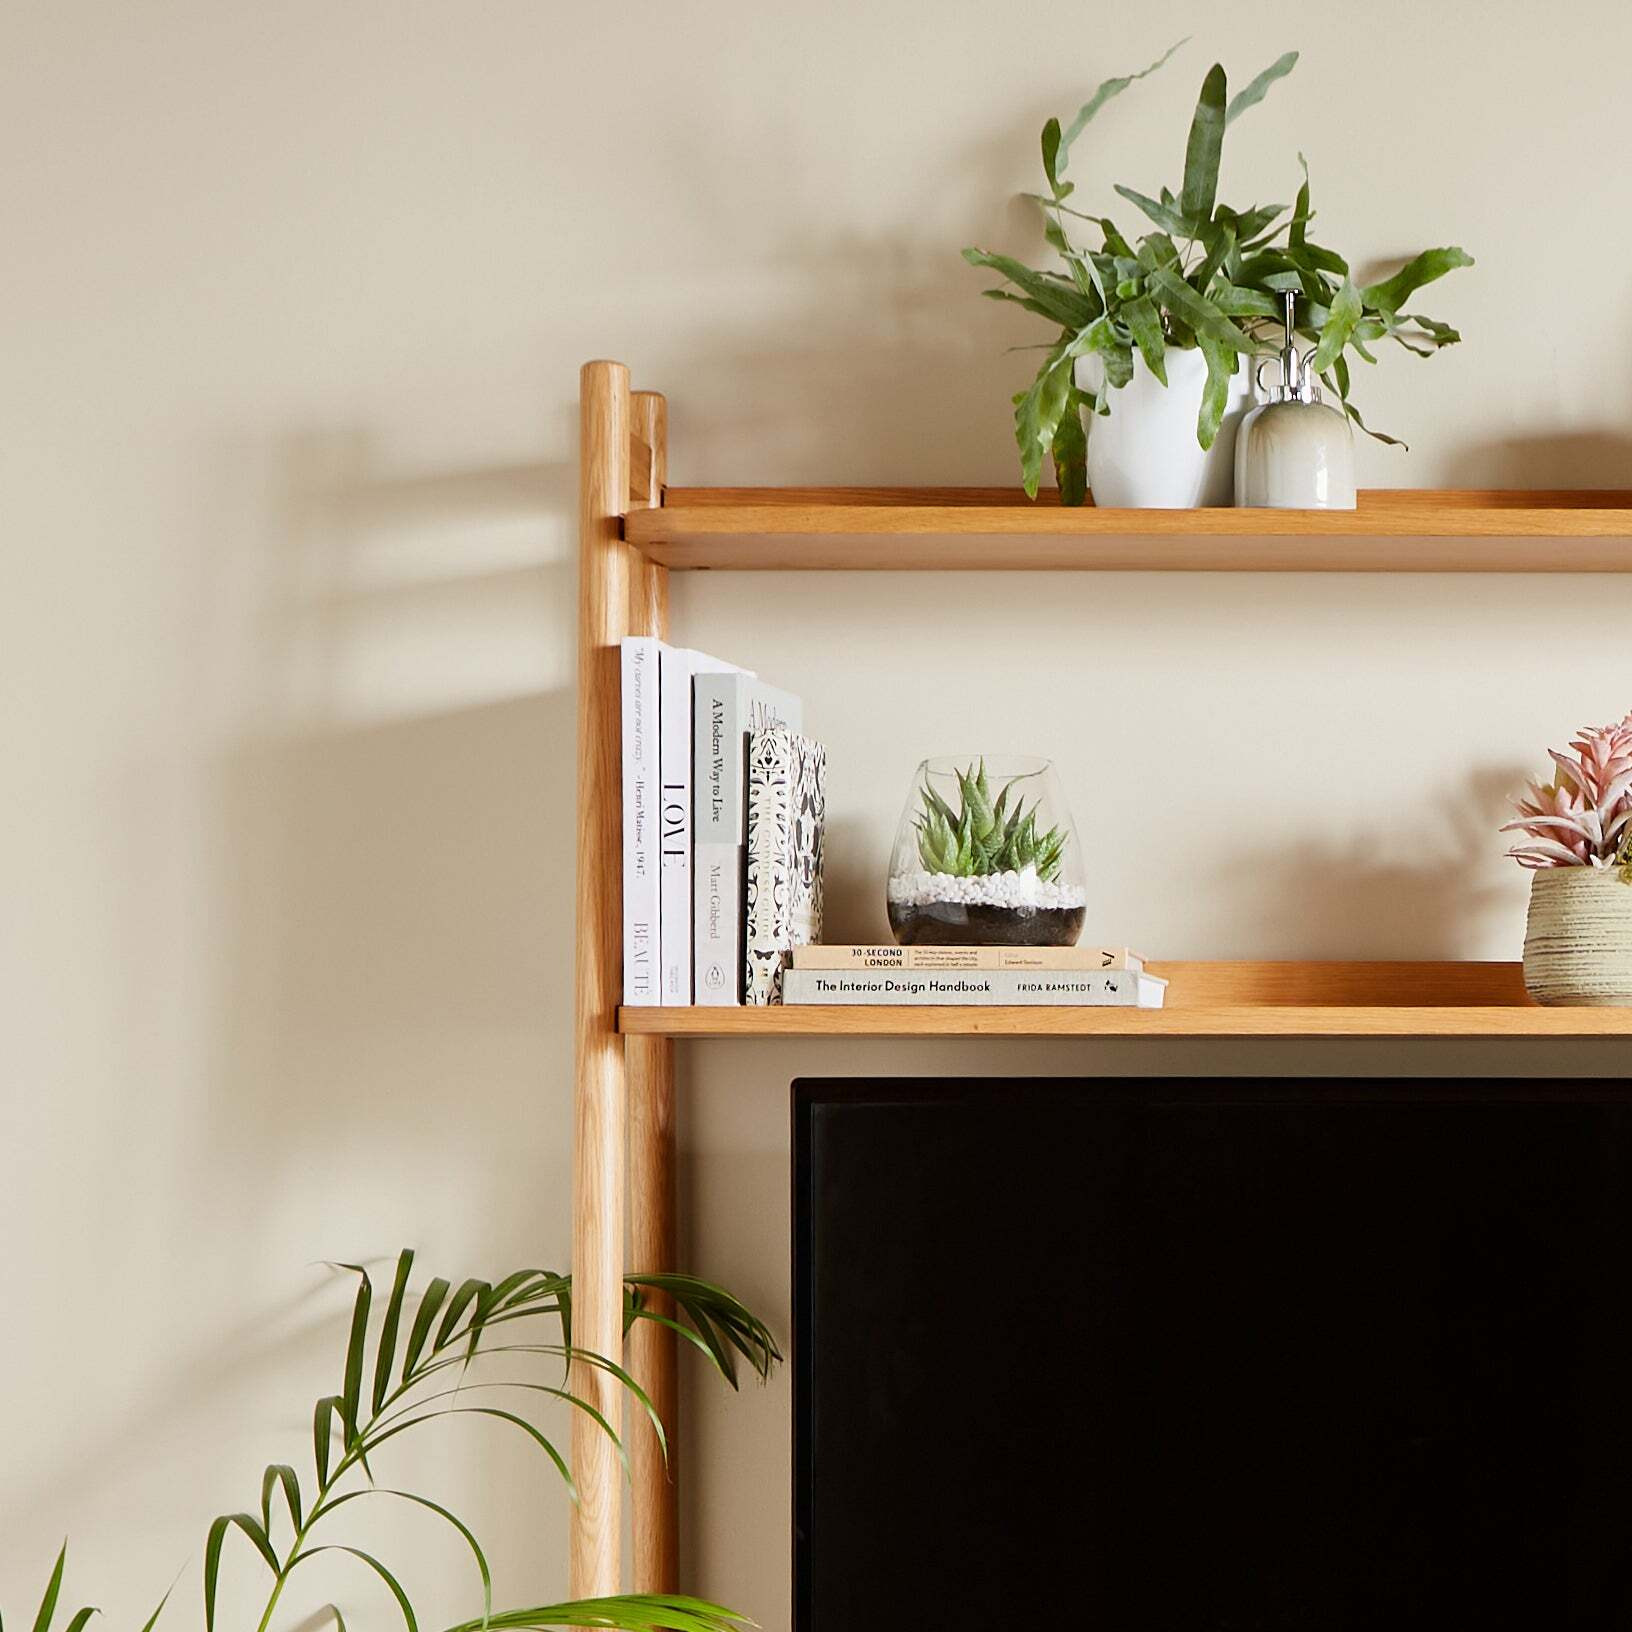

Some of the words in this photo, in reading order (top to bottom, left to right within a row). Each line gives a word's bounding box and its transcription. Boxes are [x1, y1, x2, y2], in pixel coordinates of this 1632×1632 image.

[713, 698, 724, 710] A
[712, 711, 724, 755] Modern
[709, 758, 724, 782] Way
[712, 785, 722, 797] to
[712, 798, 724, 823] Live
[663, 784, 686, 868] LOVE
[710, 864, 722, 892] Matt
[710, 895, 722, 941] Gibberd
[865, 959, 903, 967] LONDON
[816, 979, 837, 992] The
[840, 979, 883, 992] Interior
[885, 979, 926, 995] Design
[929, 979, 991, 992] Handbook
[1017, 984, 1043, 992] FRIDA
[1046, 984, 1091, 992] RAMSTEDT
